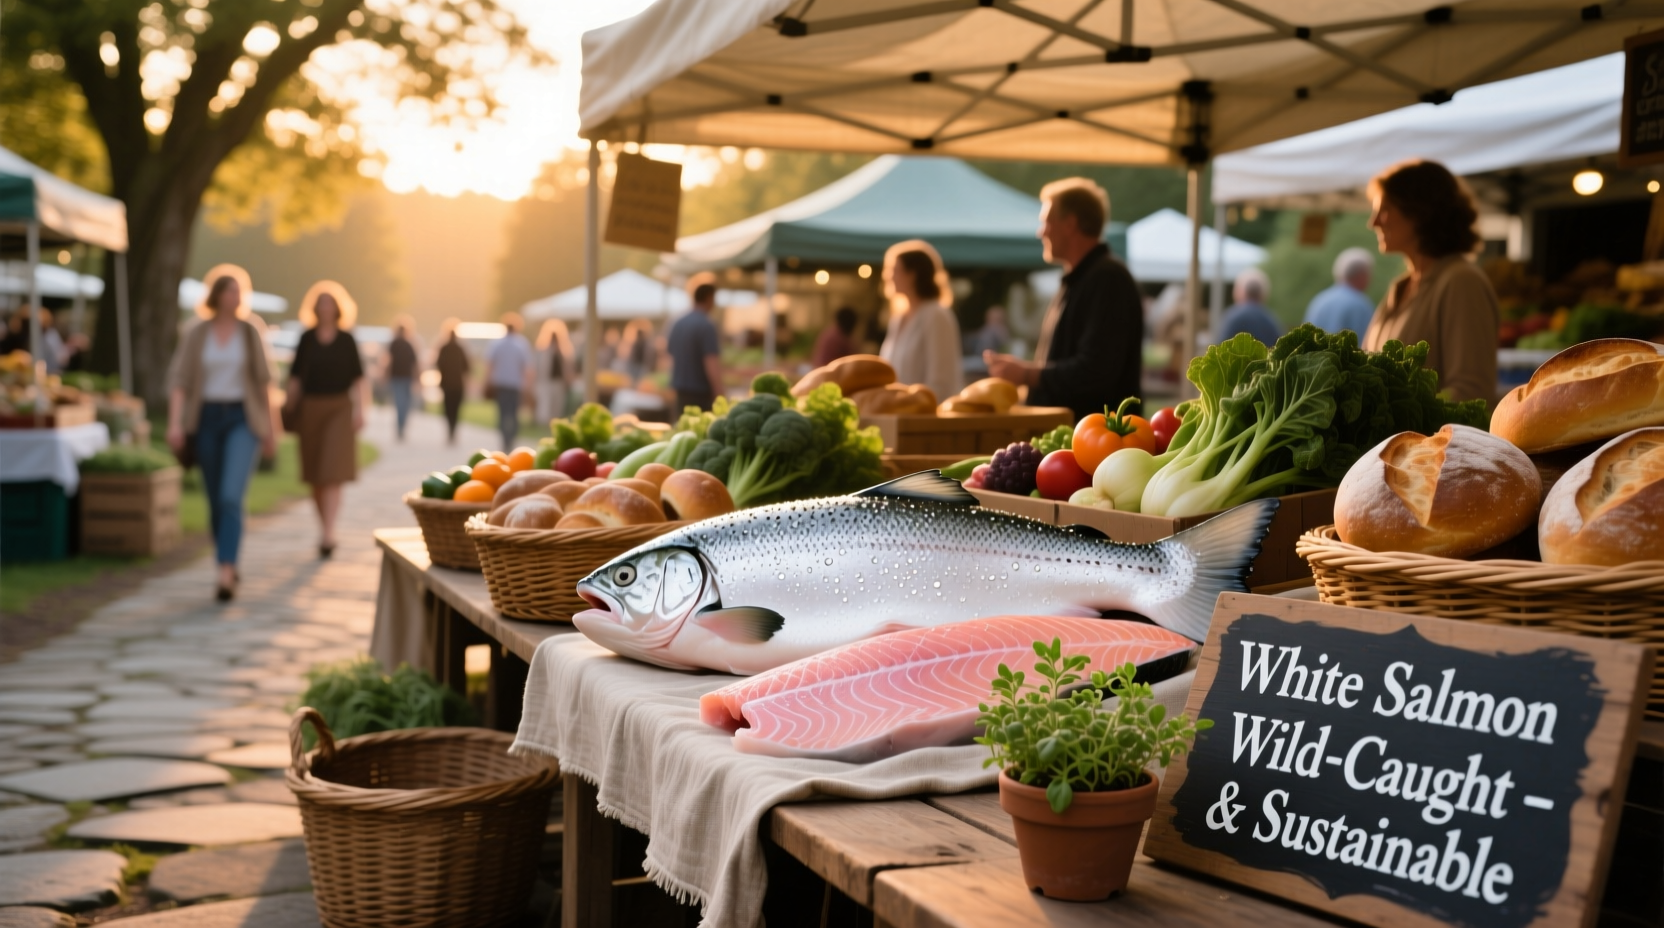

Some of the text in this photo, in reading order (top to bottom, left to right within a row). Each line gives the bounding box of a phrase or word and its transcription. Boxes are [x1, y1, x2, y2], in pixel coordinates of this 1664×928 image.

[1239, 640, 1557, 745] White Salmon
[1232, 711, 1515, 825] Wild-Caught
[1205, 780, 1514, 904] & Sustainable
